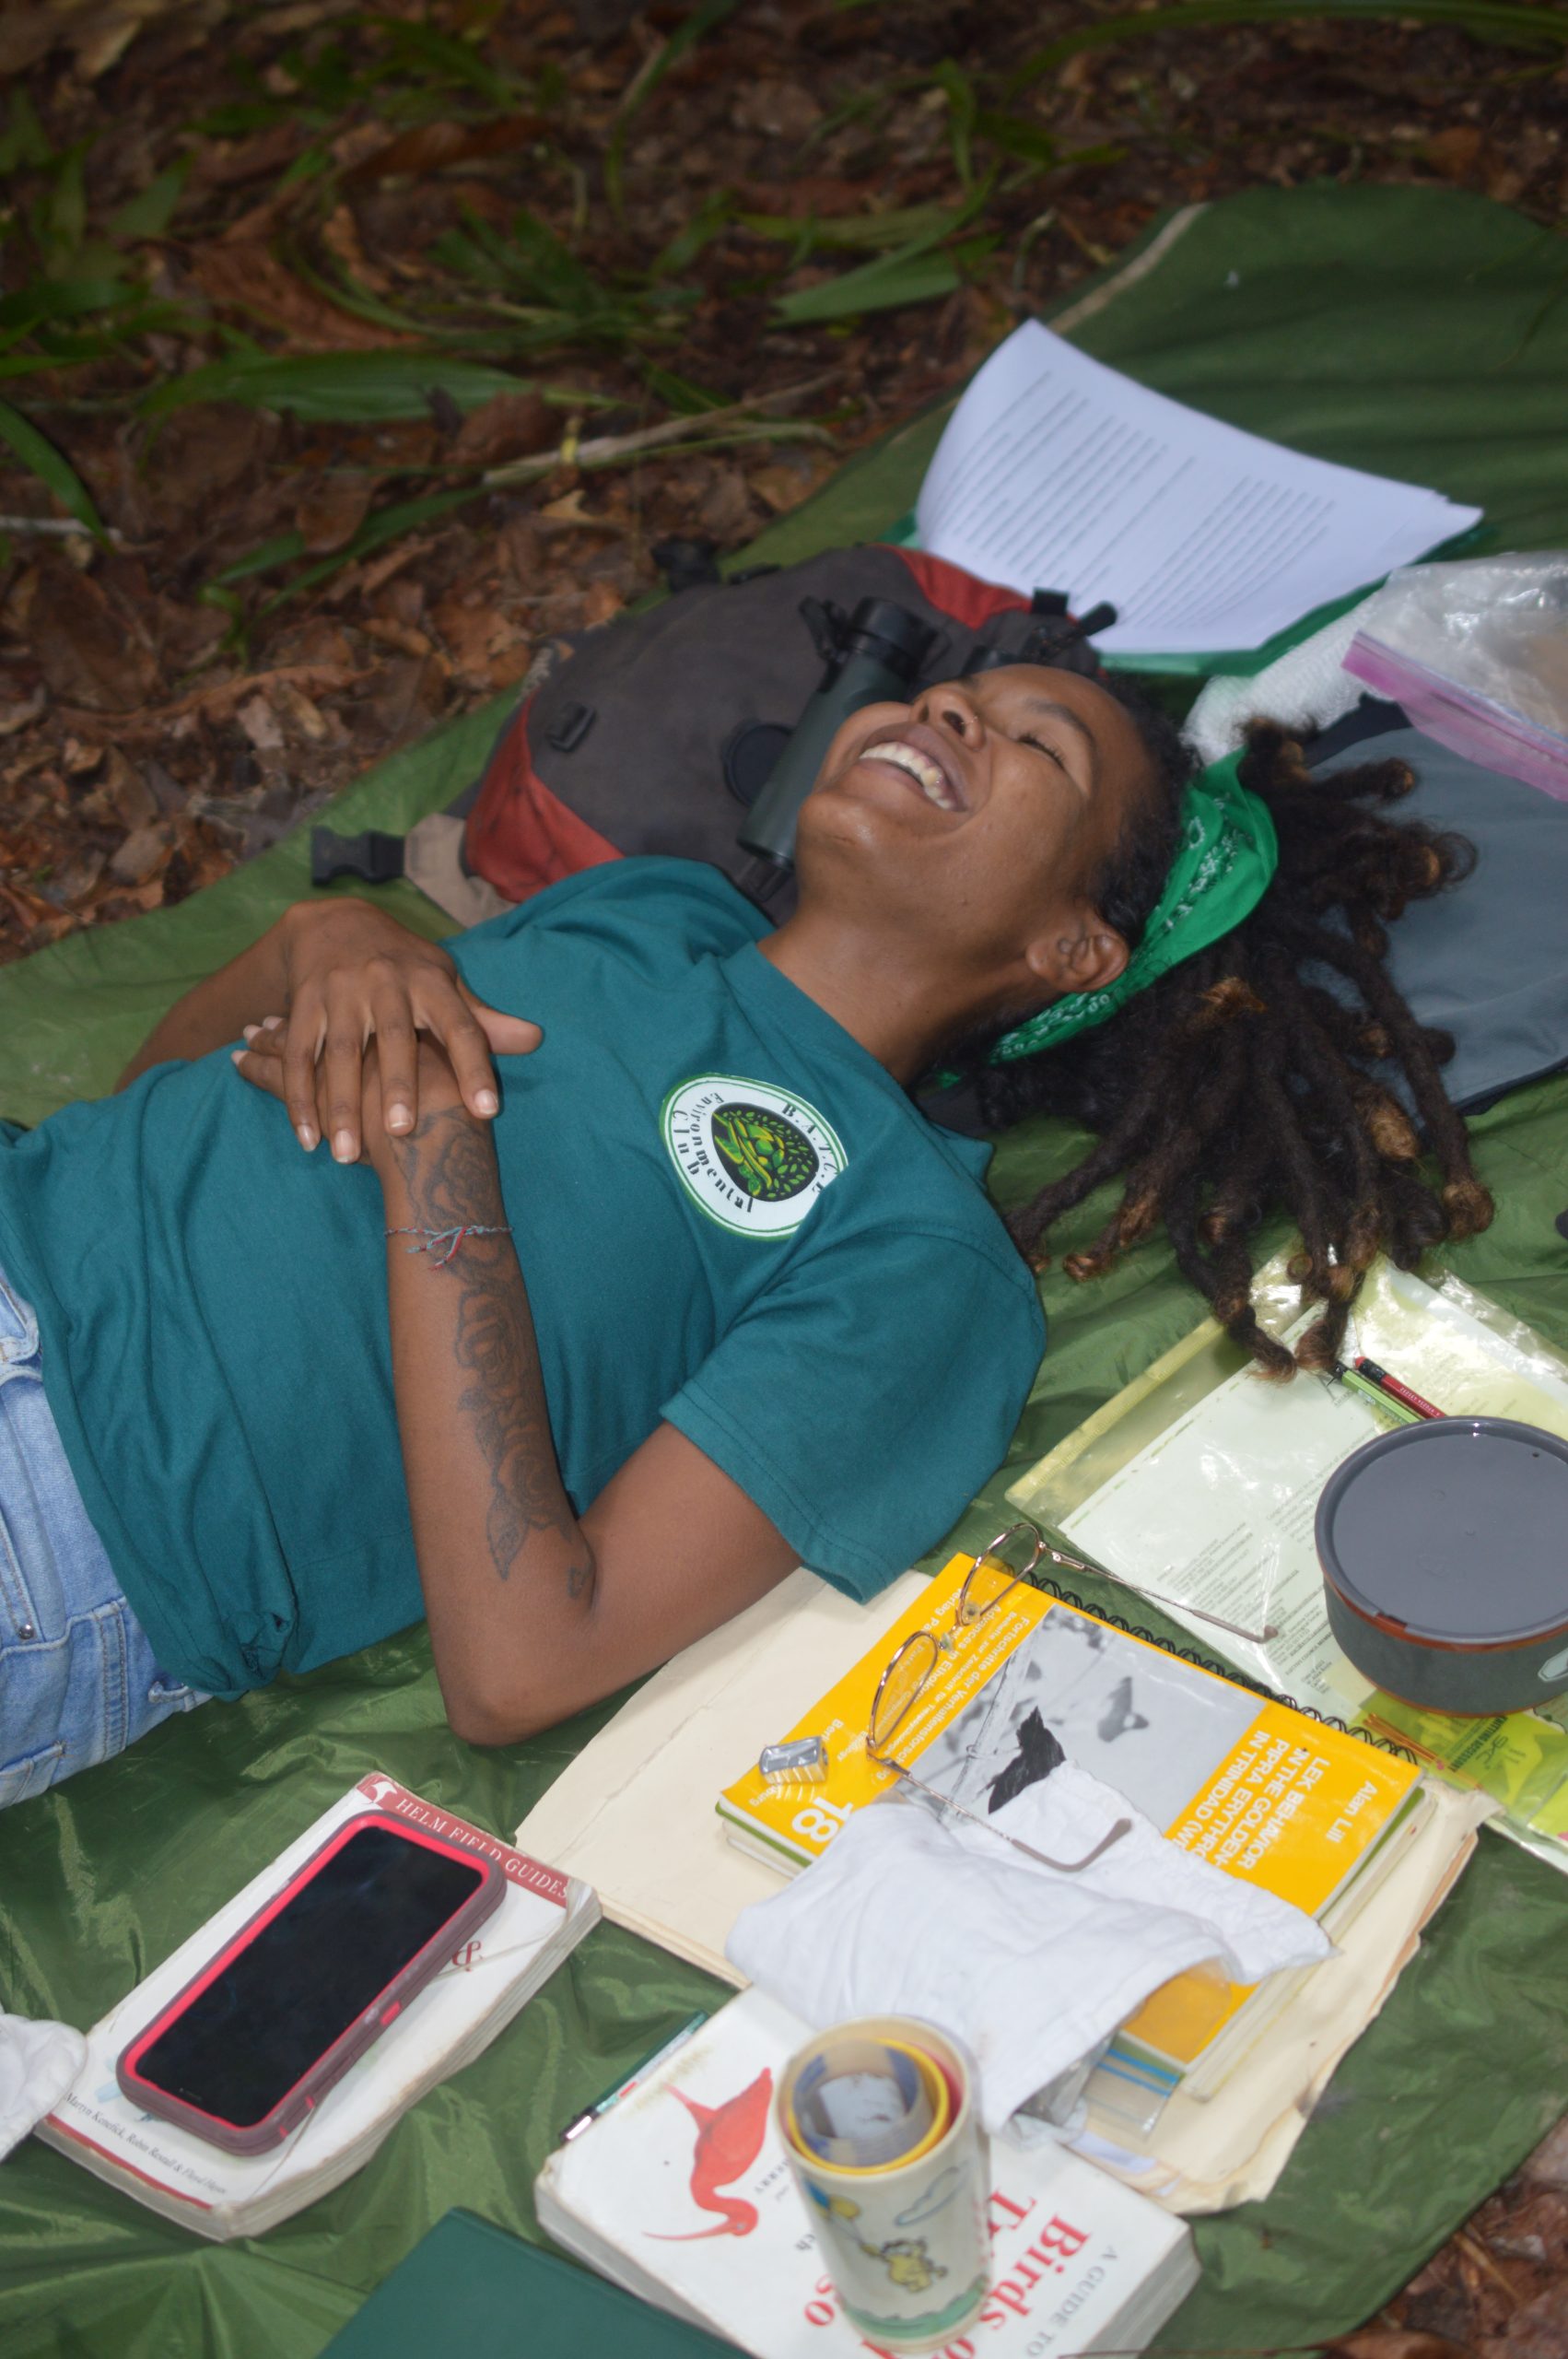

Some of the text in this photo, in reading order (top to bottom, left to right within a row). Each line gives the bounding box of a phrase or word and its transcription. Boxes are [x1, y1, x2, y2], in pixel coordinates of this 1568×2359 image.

[673, 1109, 704, 1176] Club
[690, 1092, 754, 1214] Environmental
[947, 1649, 959, 1660] in
[957, 1604, 1000, 1649] Advances
[977, 1641, 989, 1651] zur
[978, 1616, 1028, 1671] Fortschritte
[943, 1654, 977, 1691] Zeitschrift
[963, 1671, 981, 1688] der
[1246, 1731, 1268, 1751] IN
[1247, 1739, 1287, 1784] PIPRA
[1194, 1749, 1255, 1819] TRINIDAD
[1211, 1749, 1306, 1867] IN THE GOLDEN-
[1237, 1757, 1328, 1869] LEK BEHAVIOR
[1326, 1781, 1377, 1842] Alan Lill
[395, 1798, 447, 1833] HELM
[505, 1858, 568, 1899] GUIDES
[793, 1795, 853, 1845] 18
[64, 2092, 93, 2117] Martyn
[126, 2132, 150, 2153] Robin
[979, 2213, 1092, 2332] Birds
[1099, 2246, 1120, 2262] A
[1052, 2264, 1106, 2330] GUIDE
